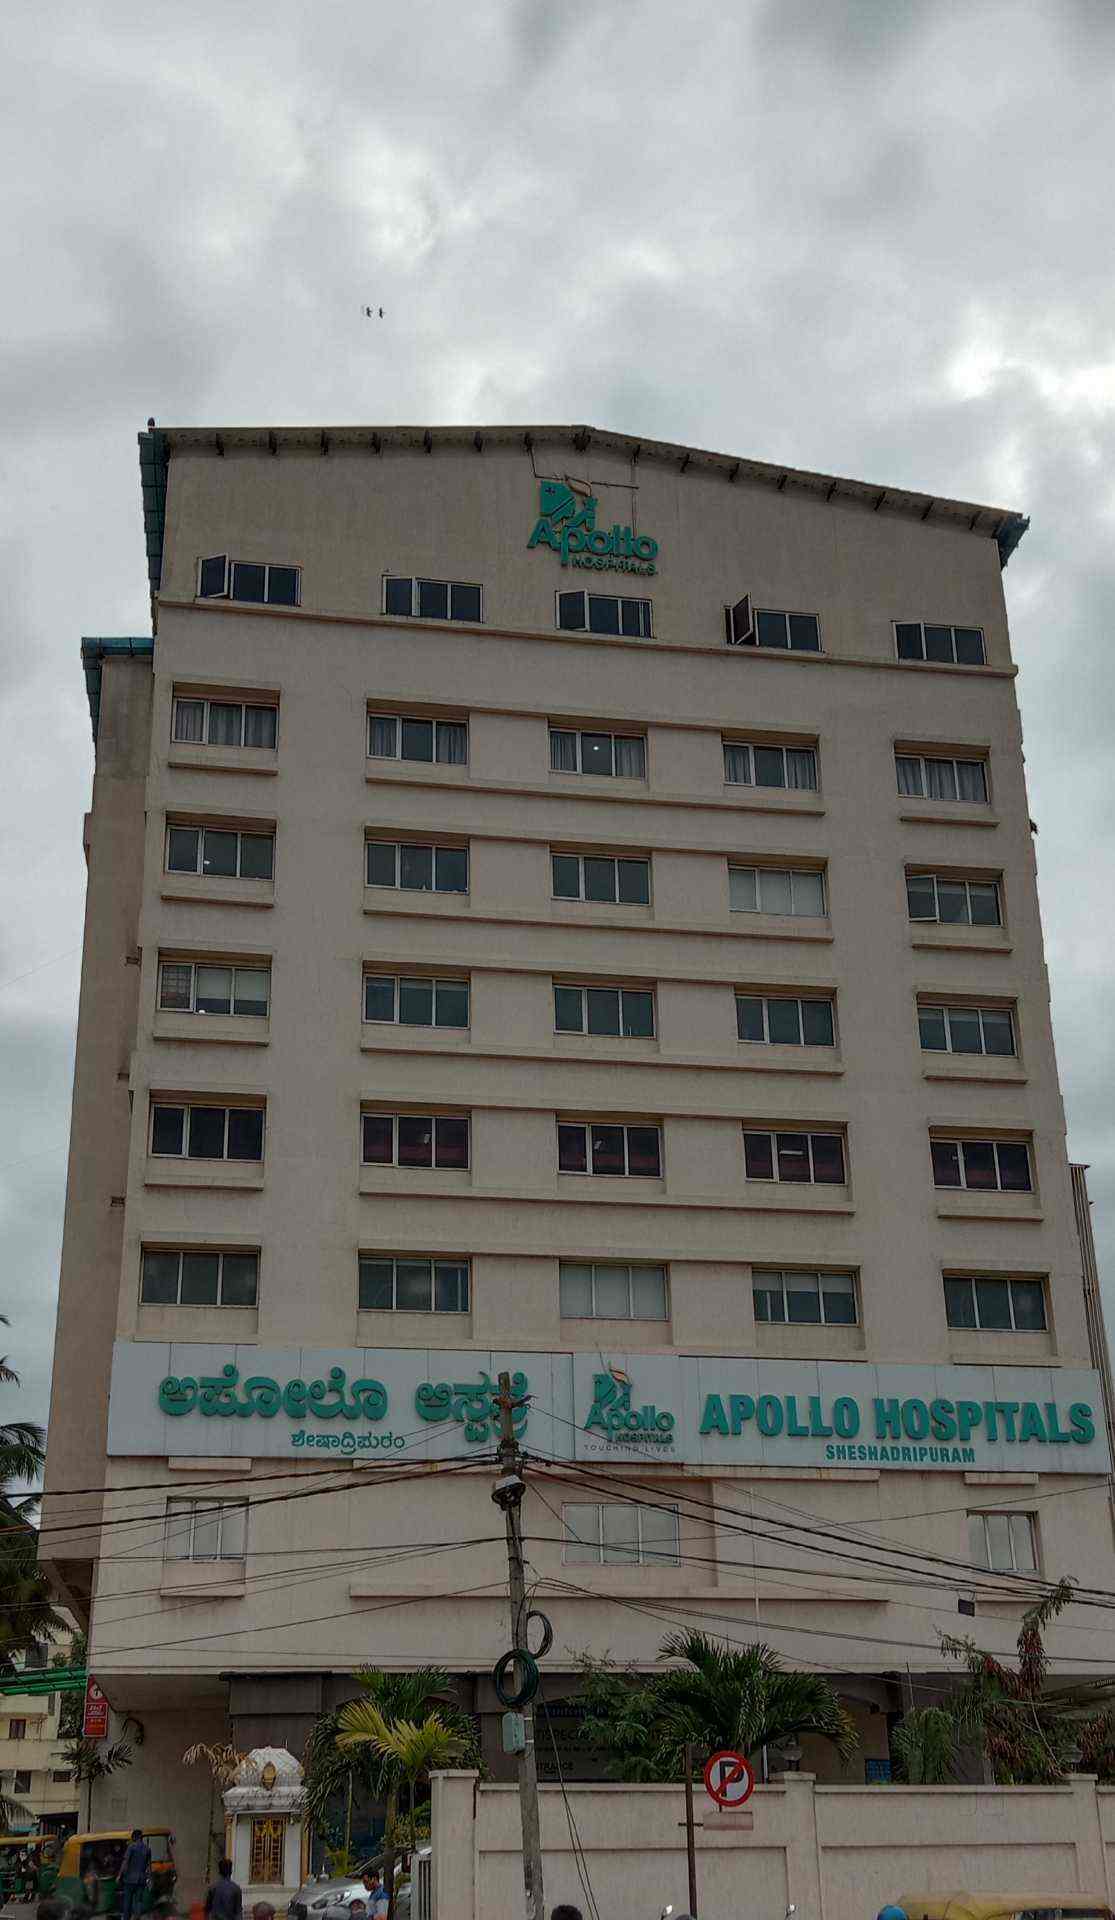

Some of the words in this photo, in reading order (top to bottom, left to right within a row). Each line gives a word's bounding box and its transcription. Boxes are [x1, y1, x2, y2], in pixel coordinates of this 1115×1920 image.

[527, 519, 659, 567] Apollo
[571, 557, 658, 576] HOSPITALS
[584, 1404, 675, 1441] Apollo
[699, 1393, 861, 1440] APOLLO
[873, 1397, 1095, 1444] HOSPITALS
[614, 1431, 674, 1444] HOSPITALS
[825, 1443, 976, 1464] SHESHADRIPURAM
